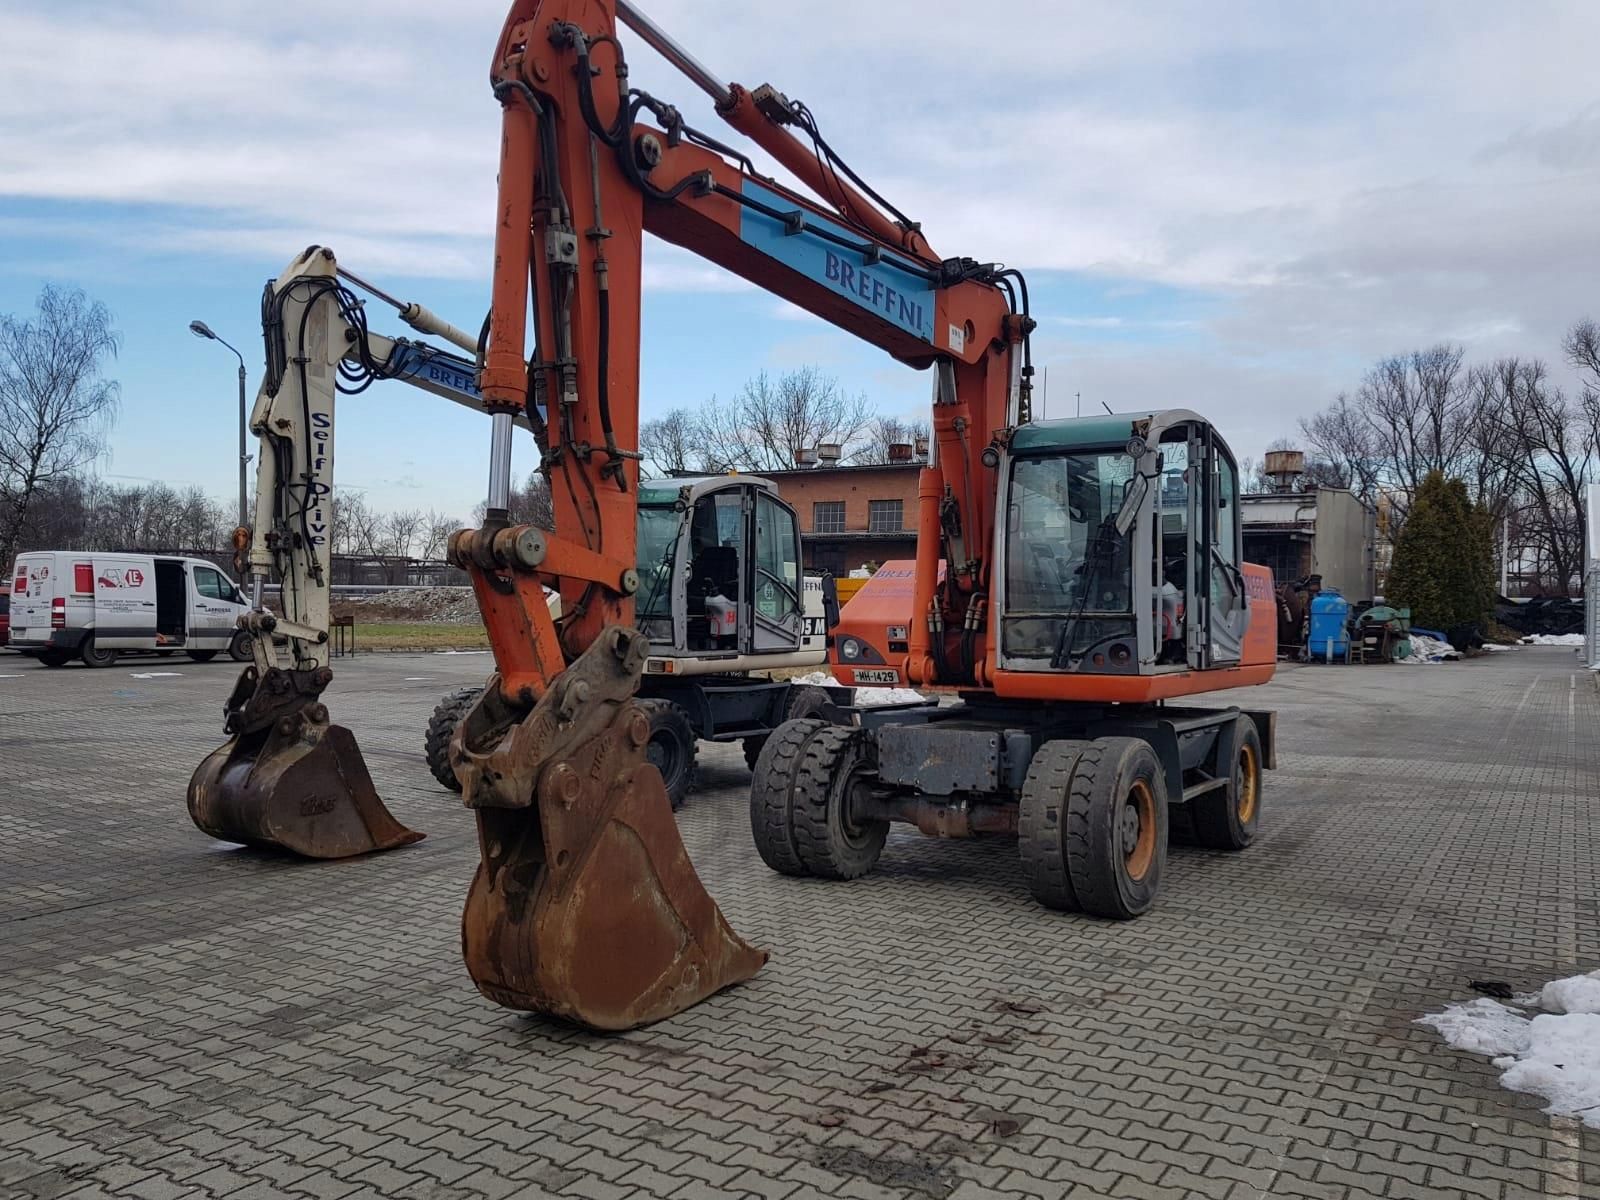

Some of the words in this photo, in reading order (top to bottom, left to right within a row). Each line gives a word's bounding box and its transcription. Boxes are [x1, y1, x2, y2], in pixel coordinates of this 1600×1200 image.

[825, 253, 923, 330] BREFFNI
[311, 413, 331, 471] Self
[310, 482, 331, 545] Drive
